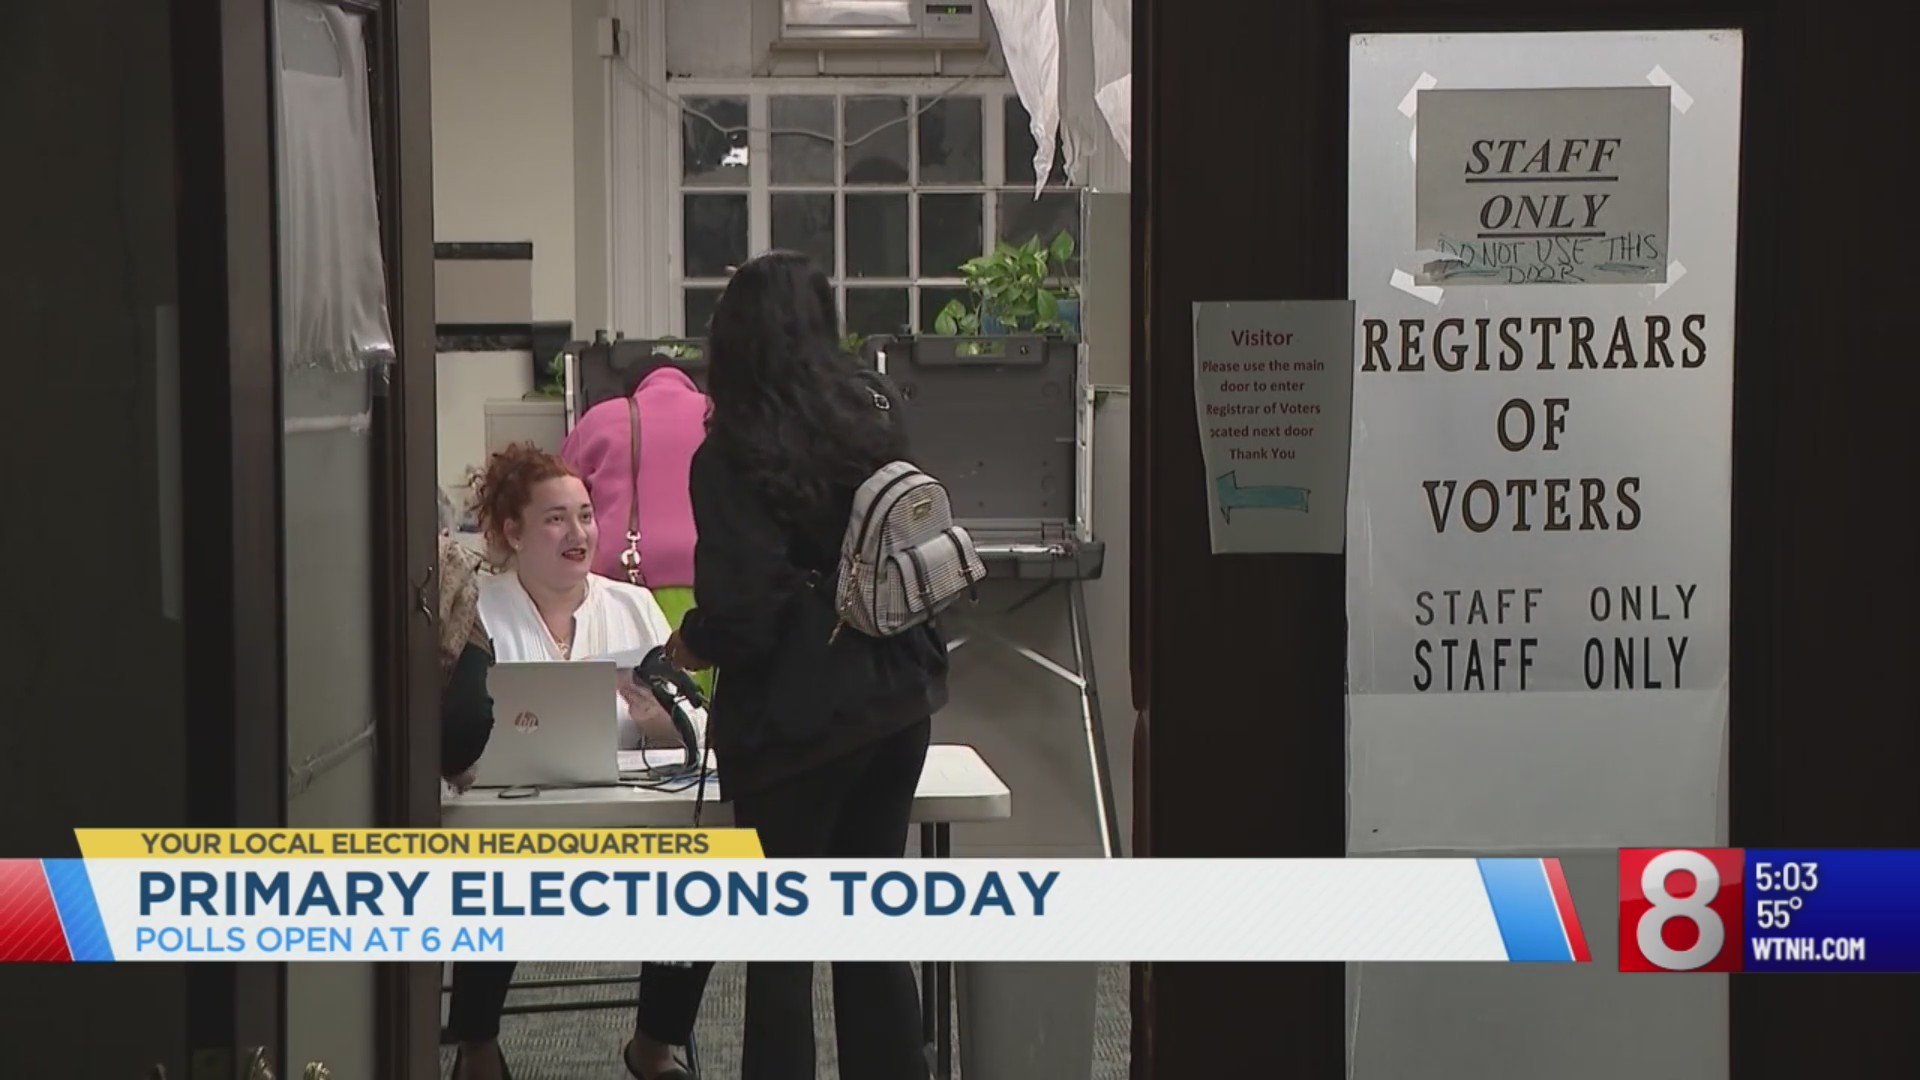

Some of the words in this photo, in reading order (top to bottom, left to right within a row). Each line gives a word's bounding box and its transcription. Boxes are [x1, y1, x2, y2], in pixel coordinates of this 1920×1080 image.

[1465, 138, 1621, 175] STAFF
[1480, 194, 1611, 230] ONLY
[1483, 241, 1525, 267] NOT
[1536, 236, 1592, 265] USE
[1601, 232, 1658, 262] THIS
[1502, 264, 1585, 284] DOOR
[1231, 329, 1293, 346] Visitor
[1361, 314, 1707, 373] REGISTRARS
[1202, 360, 1240, 372] Please
[1243, 361, 1265, 372] use
[1269, 359, 1290, 371] the
[1294, 359, 1324, 371] main
[1220, 379, 1250, 392] door
[1253, 381, 1267, 392] to
[1270, 381, 1304, 391] enter
[1206, 403, 1259, 417] Registrar
[1263, 402, 1277, 414] of
[1280, 402, 1321, 414] Voters
[1497, 398, 1570, 452] OF
[1252, 426, 1280, 438] next
[1284, 424, 1314, 437] door
[1230, 447, 1268, 460] Thank
[1271, 447, 1295, 460] You
[1422, 476, 1641, 534] VOTERS
[1415, 588, 1543, 626] STAFF
[1590, 584, 1697, 622] ONLY
[1413, 637, 1538, 692] STAFF
[1583, 636, 1689, 691] ONLY
